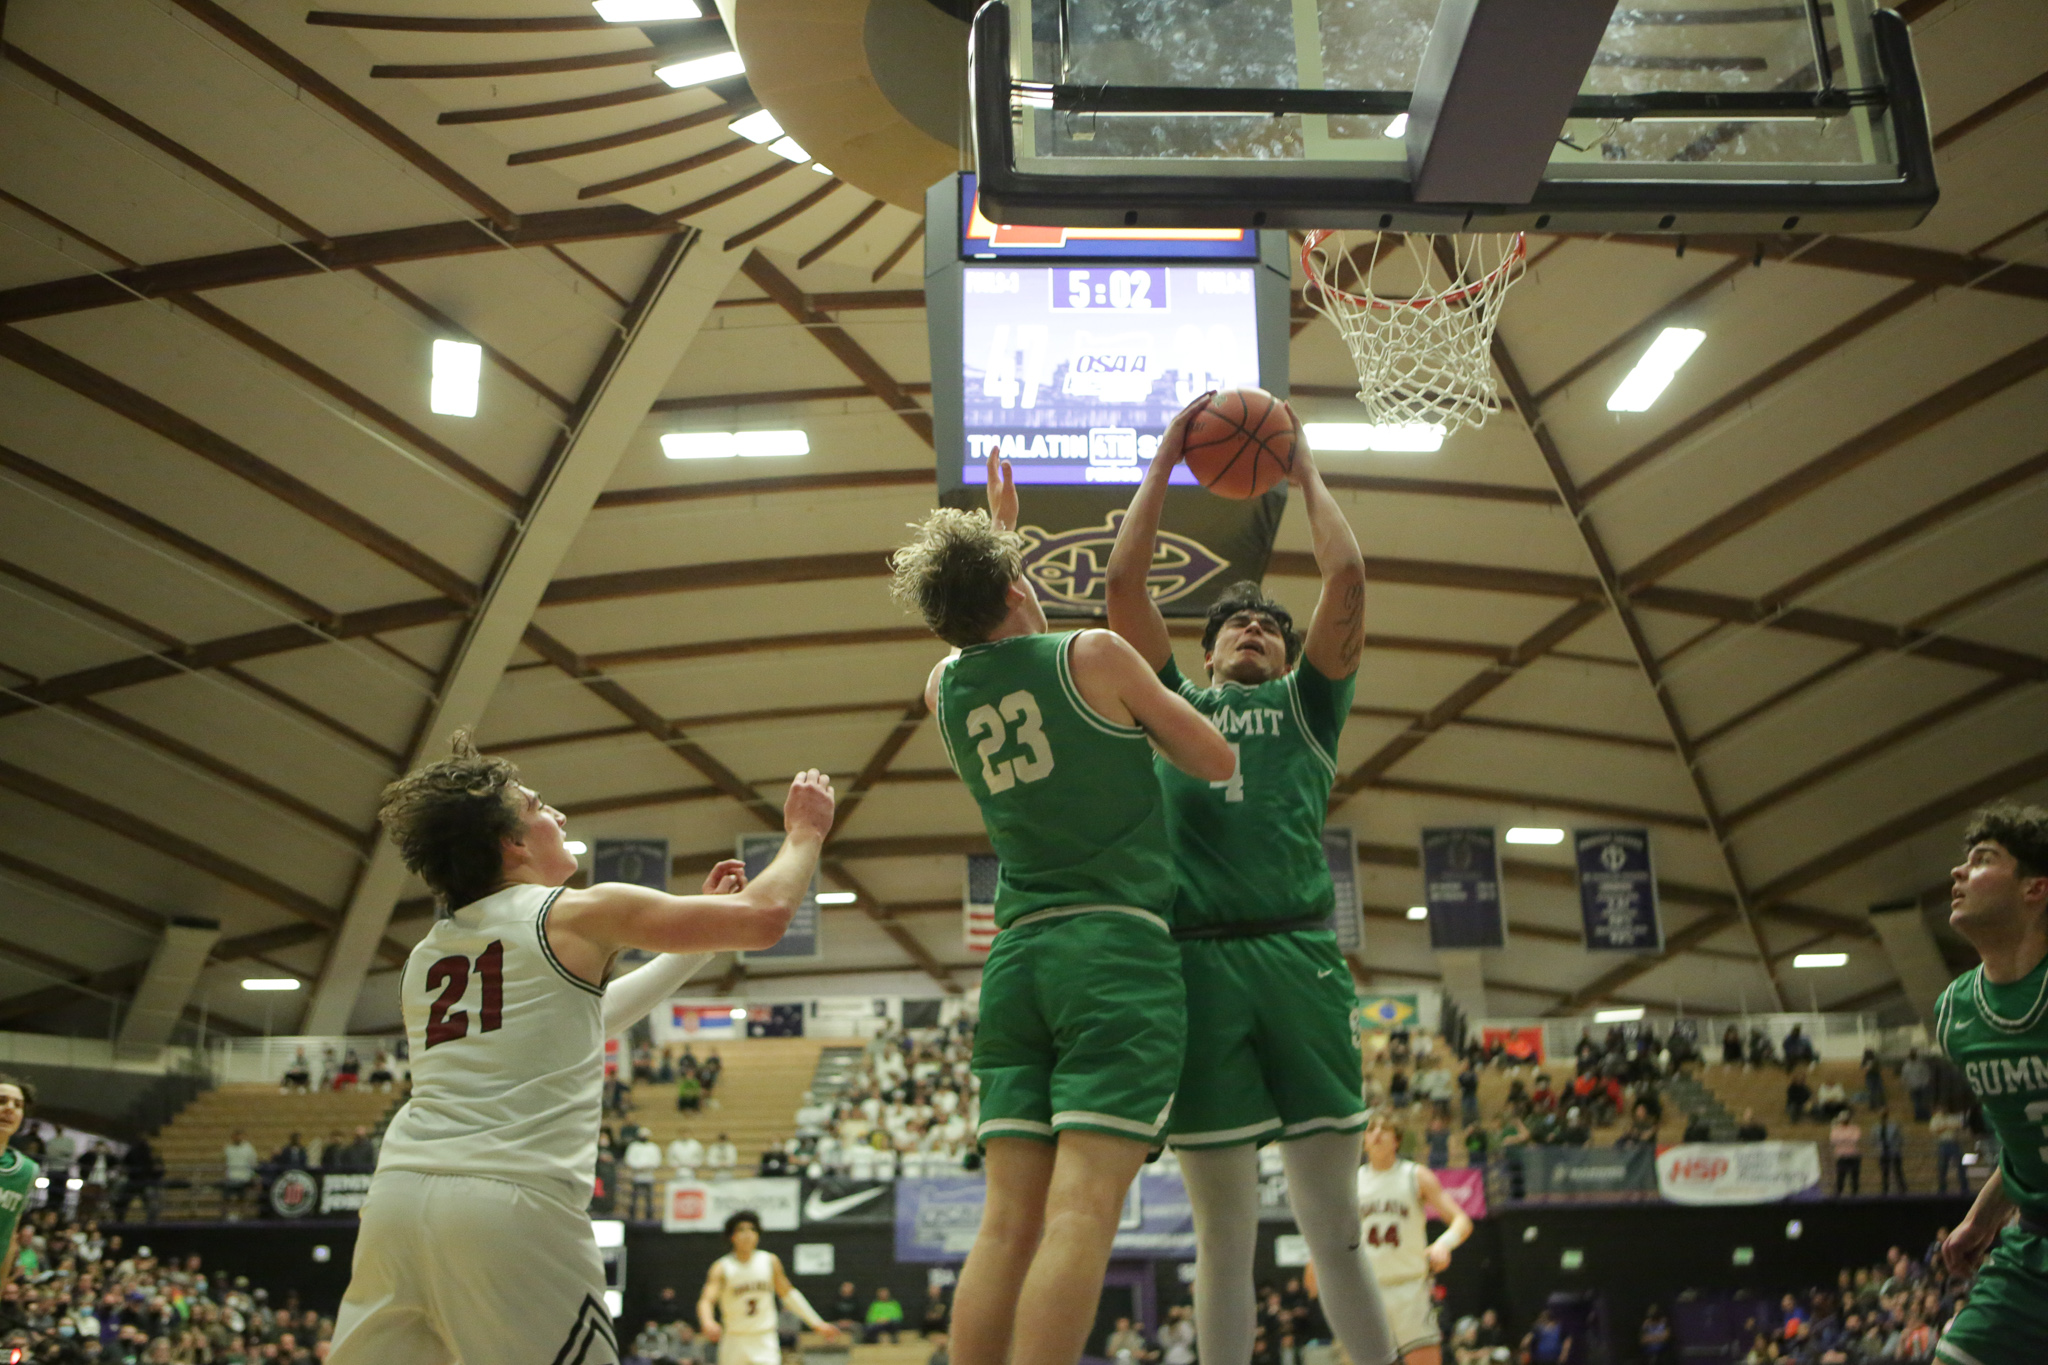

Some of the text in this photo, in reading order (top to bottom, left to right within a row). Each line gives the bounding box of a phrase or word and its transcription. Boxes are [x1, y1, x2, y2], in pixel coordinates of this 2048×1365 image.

[1068, 270, 1152, 308] 5:02
[1076, 355, 1147, 373] OSAA
[966, 434, 1089, 459] TUALATIN
[1212, 705, 1284, 736] MMIT
[965, 689, 1055, 795] 23
[425, 938, 504, 1051] 21
